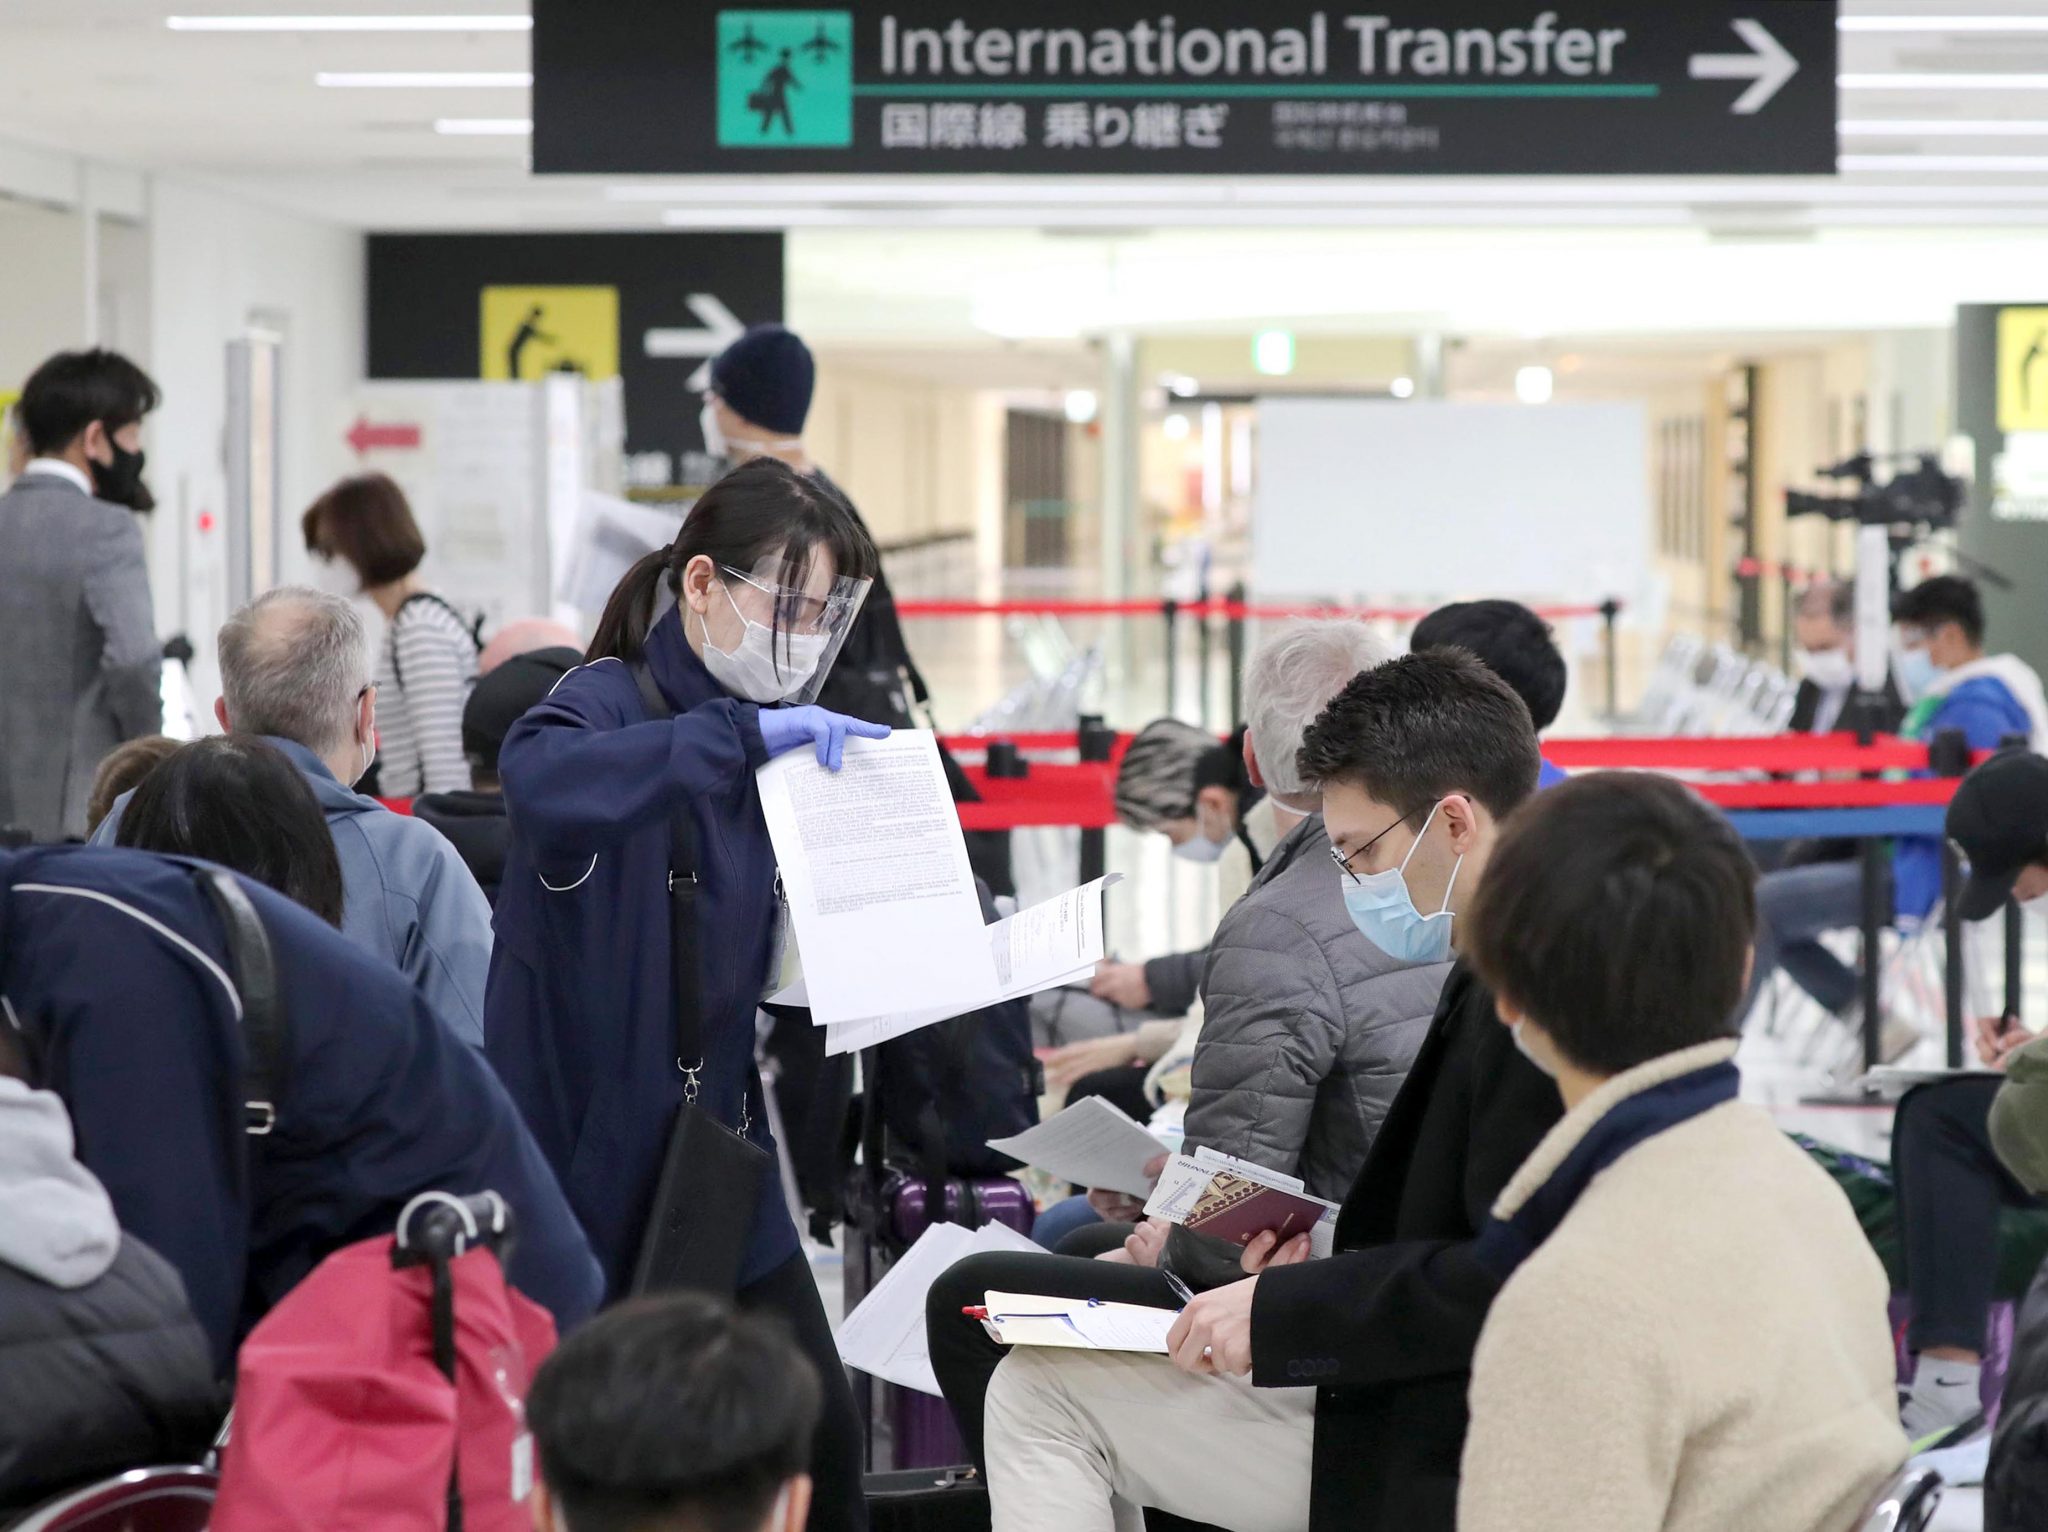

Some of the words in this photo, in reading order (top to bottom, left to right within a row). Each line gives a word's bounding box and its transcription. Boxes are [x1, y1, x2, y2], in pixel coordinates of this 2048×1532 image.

[881, 11, 1327, 76] International
[1343, 11, 1627, 76] Transfer
[881, 102, 1027, 148] 国際線
[1042, 102, 1230, 149] 乗り継ぎ
